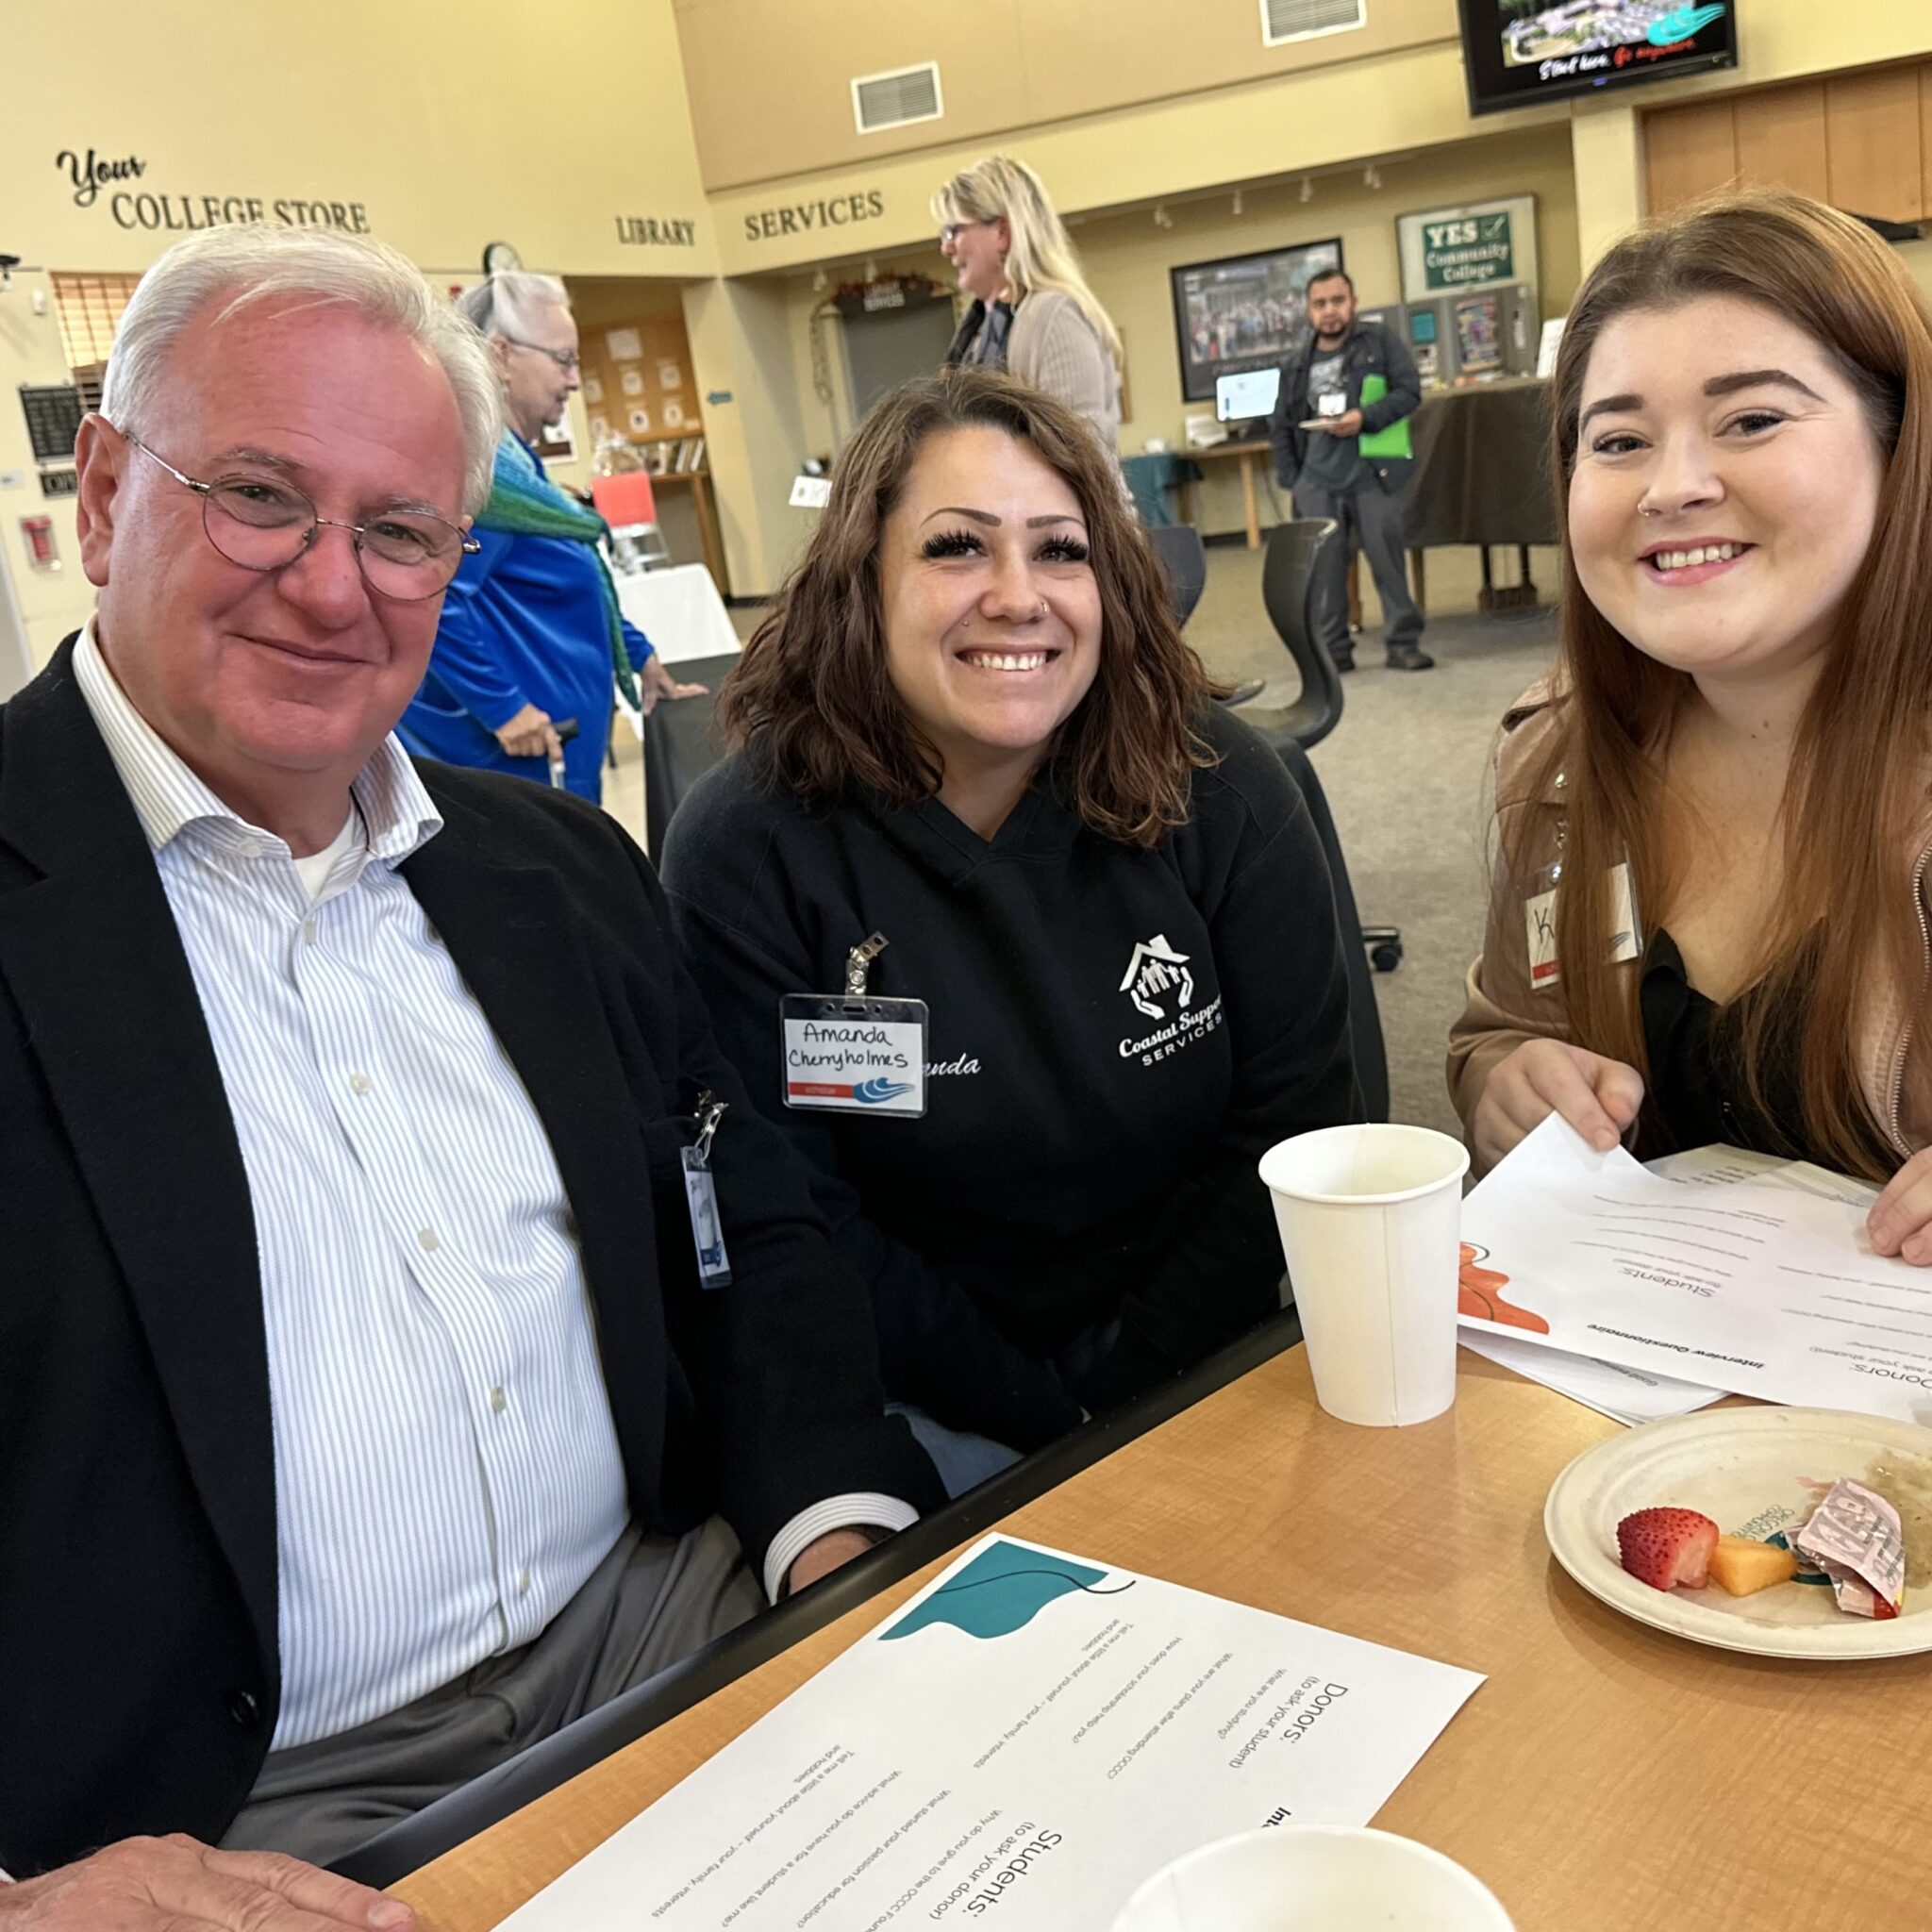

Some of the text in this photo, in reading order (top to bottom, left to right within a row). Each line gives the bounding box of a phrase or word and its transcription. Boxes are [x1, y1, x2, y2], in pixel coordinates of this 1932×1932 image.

[57, 148, 146, 208] Your
[110, 192, 372, 235] COLLEGE STORE
[744, 190, 885, 242] SERVICES
[615, 216, 695, 247] LIBRARY
[1426, 220, 1478, 249] YES
[1426, 242, 1510, 269] Community
[1442, 263, 1496, 283] College
[804, 1022, 893, 1047] Amanda
[1119, 1023, 1178, 1058] Coastal
[1141, 1012, 1223, 1067] SERVICES
[789, 1048, 908, 1072] Cherryholmes
[1586, 1324, 1764, 1369] Interview Questionnaire
[1227, 1675, 1321, 1769] (to ask your student)
[1280, 1682, 1349, 1744] Donors:
[823, 1762, 839, 1774] me
[836, 1750, 856, 1764] Tell
[799, 1778, 821, 1795] little
[876, 1771, 902, 1789] What
[775, 1793, 801, 1815] about
[852, 1787, 879, 1810] advice
[743, 1812, 778, 1843] yourself
[824, 1818, 843, 1834] you
[841, 1809, 855, 1821] do
[718, 1845, 739, 1865] your
[793, 1850, 809, 1863] for
[805, 1833, 829, 1852] have
[796, 1790, 952, 1929] What started your passion for education?
[864, 1809, 1003, 1932] Why do you give to the OCCC Foun
[928, 1822, 1036, 1921] (to ask your donor)
[963, 1829, 1063, 1918] Students:
[754, 1867, 789, 1896] student
[651, 1886, 692, 1918] interests
[739, 1894, 759, 1910] like
[722, 1908, 741, 1928] me?
